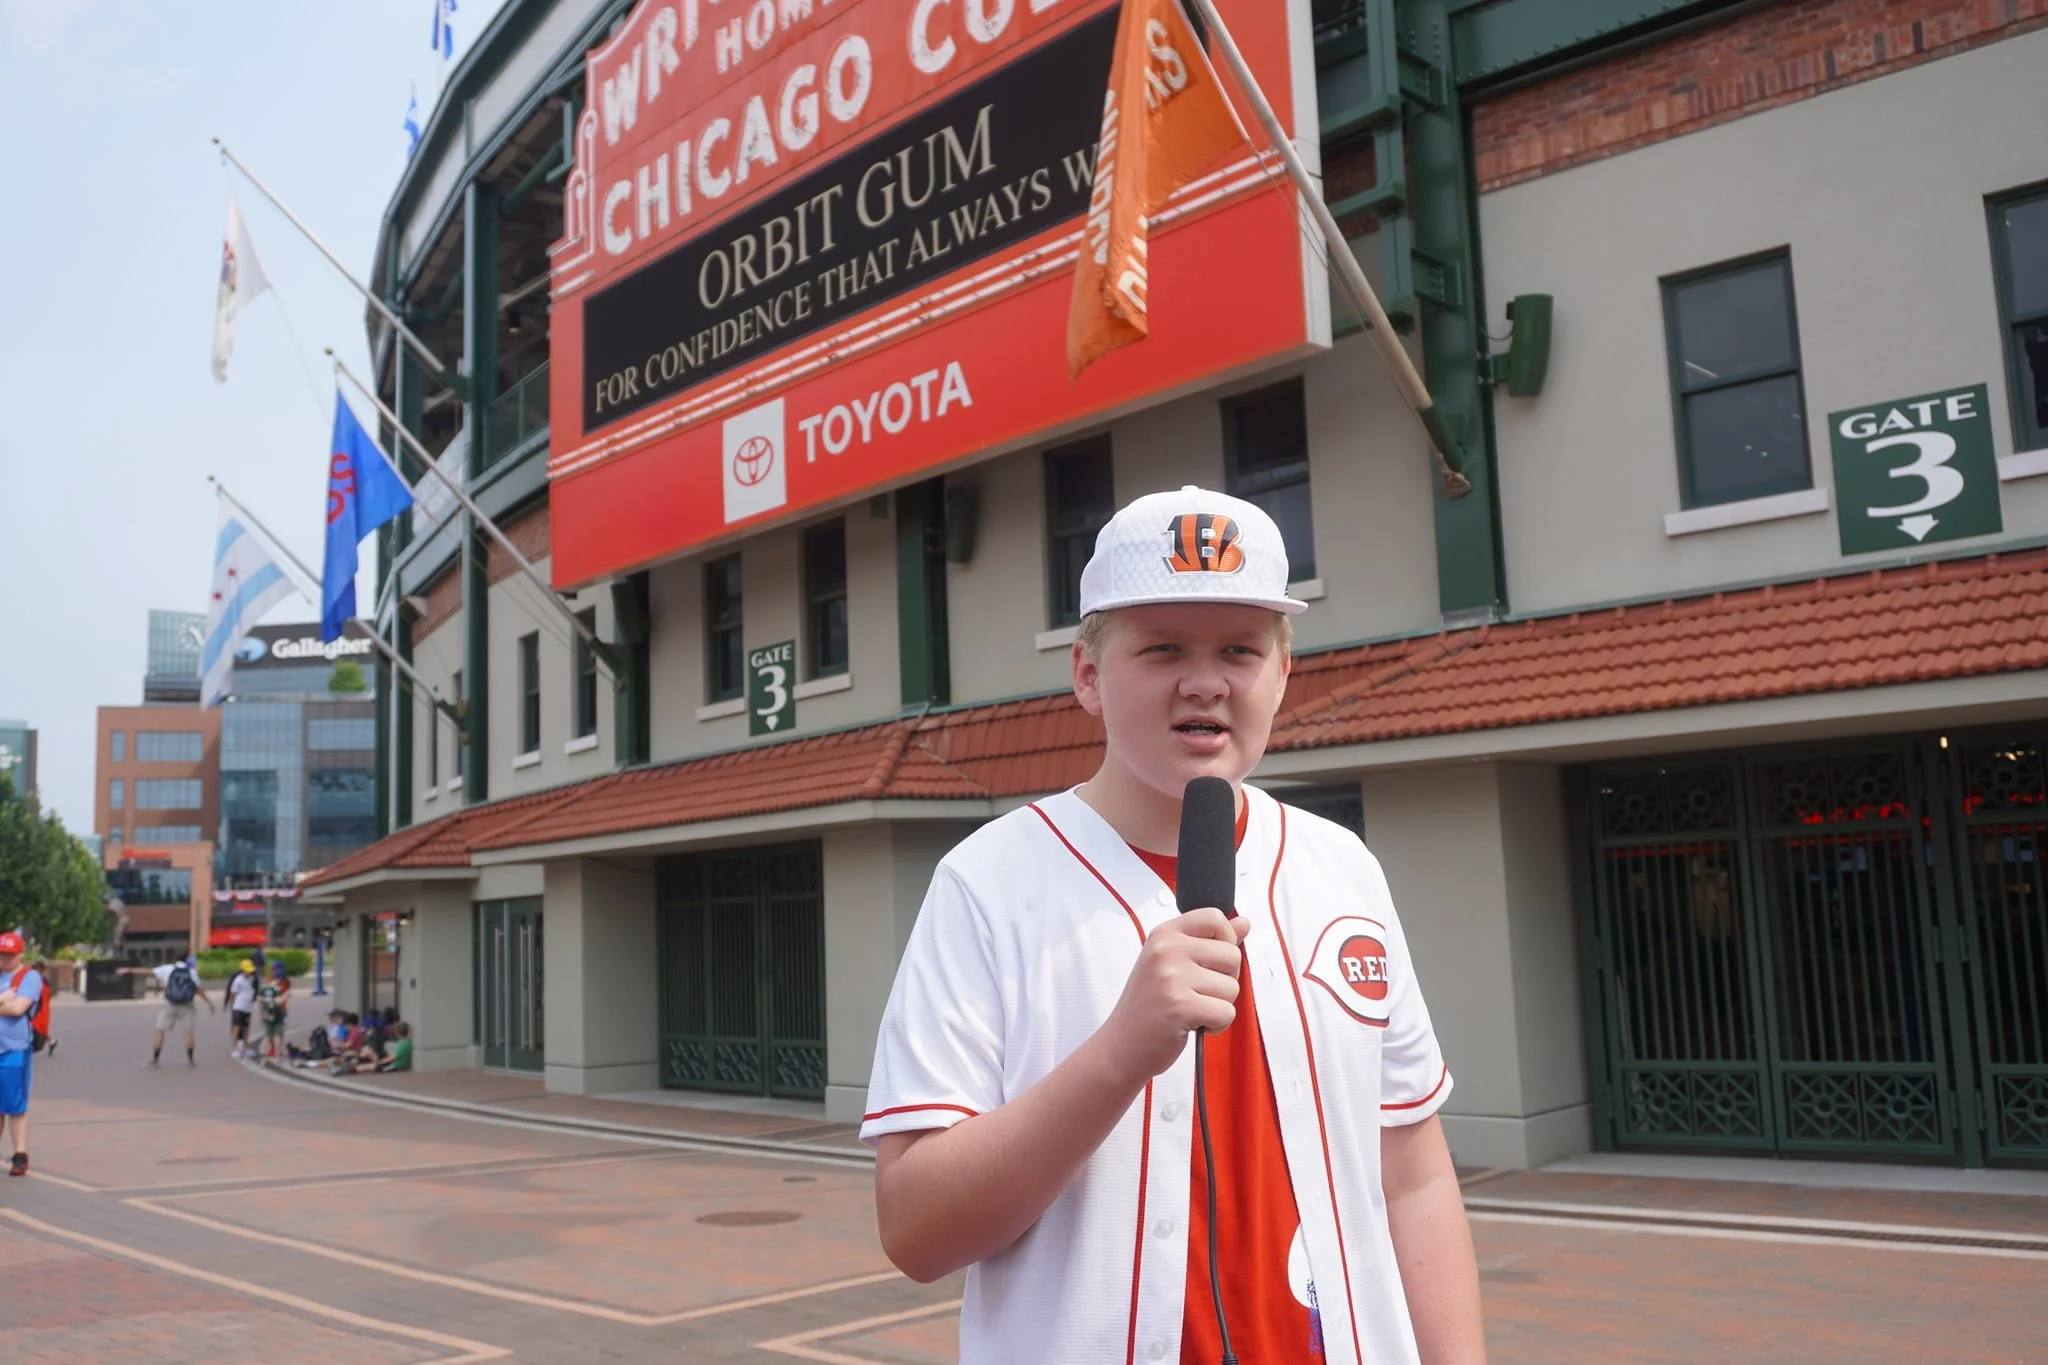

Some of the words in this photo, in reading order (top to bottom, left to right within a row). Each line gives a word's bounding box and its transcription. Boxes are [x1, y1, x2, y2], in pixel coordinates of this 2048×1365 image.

[601, 0, 723, 147] WRI
[713, 0, 837, 75] HOM
[601, 34, 872, 256] CHICAGO
[699, 184, 844, 310] ORBIT
[855, 103, 997, 229] GUM
[594, 365, 641, 412] FOR
[644, 279, 813, 389] CONFIDENCE
[817, 238, 900, 308] THAT
[905, 167, 1054, 271] ALWAYS
[798, 360, 974, 464] TOYOTA
[1839, 392, 1978, 440] GATE
[1865, 430, 1965, 518] 3
[271, 635, 372, 660] Gallagher
[751, 644, 793, 668] GATE
[756, 665, 788, 717] 3
